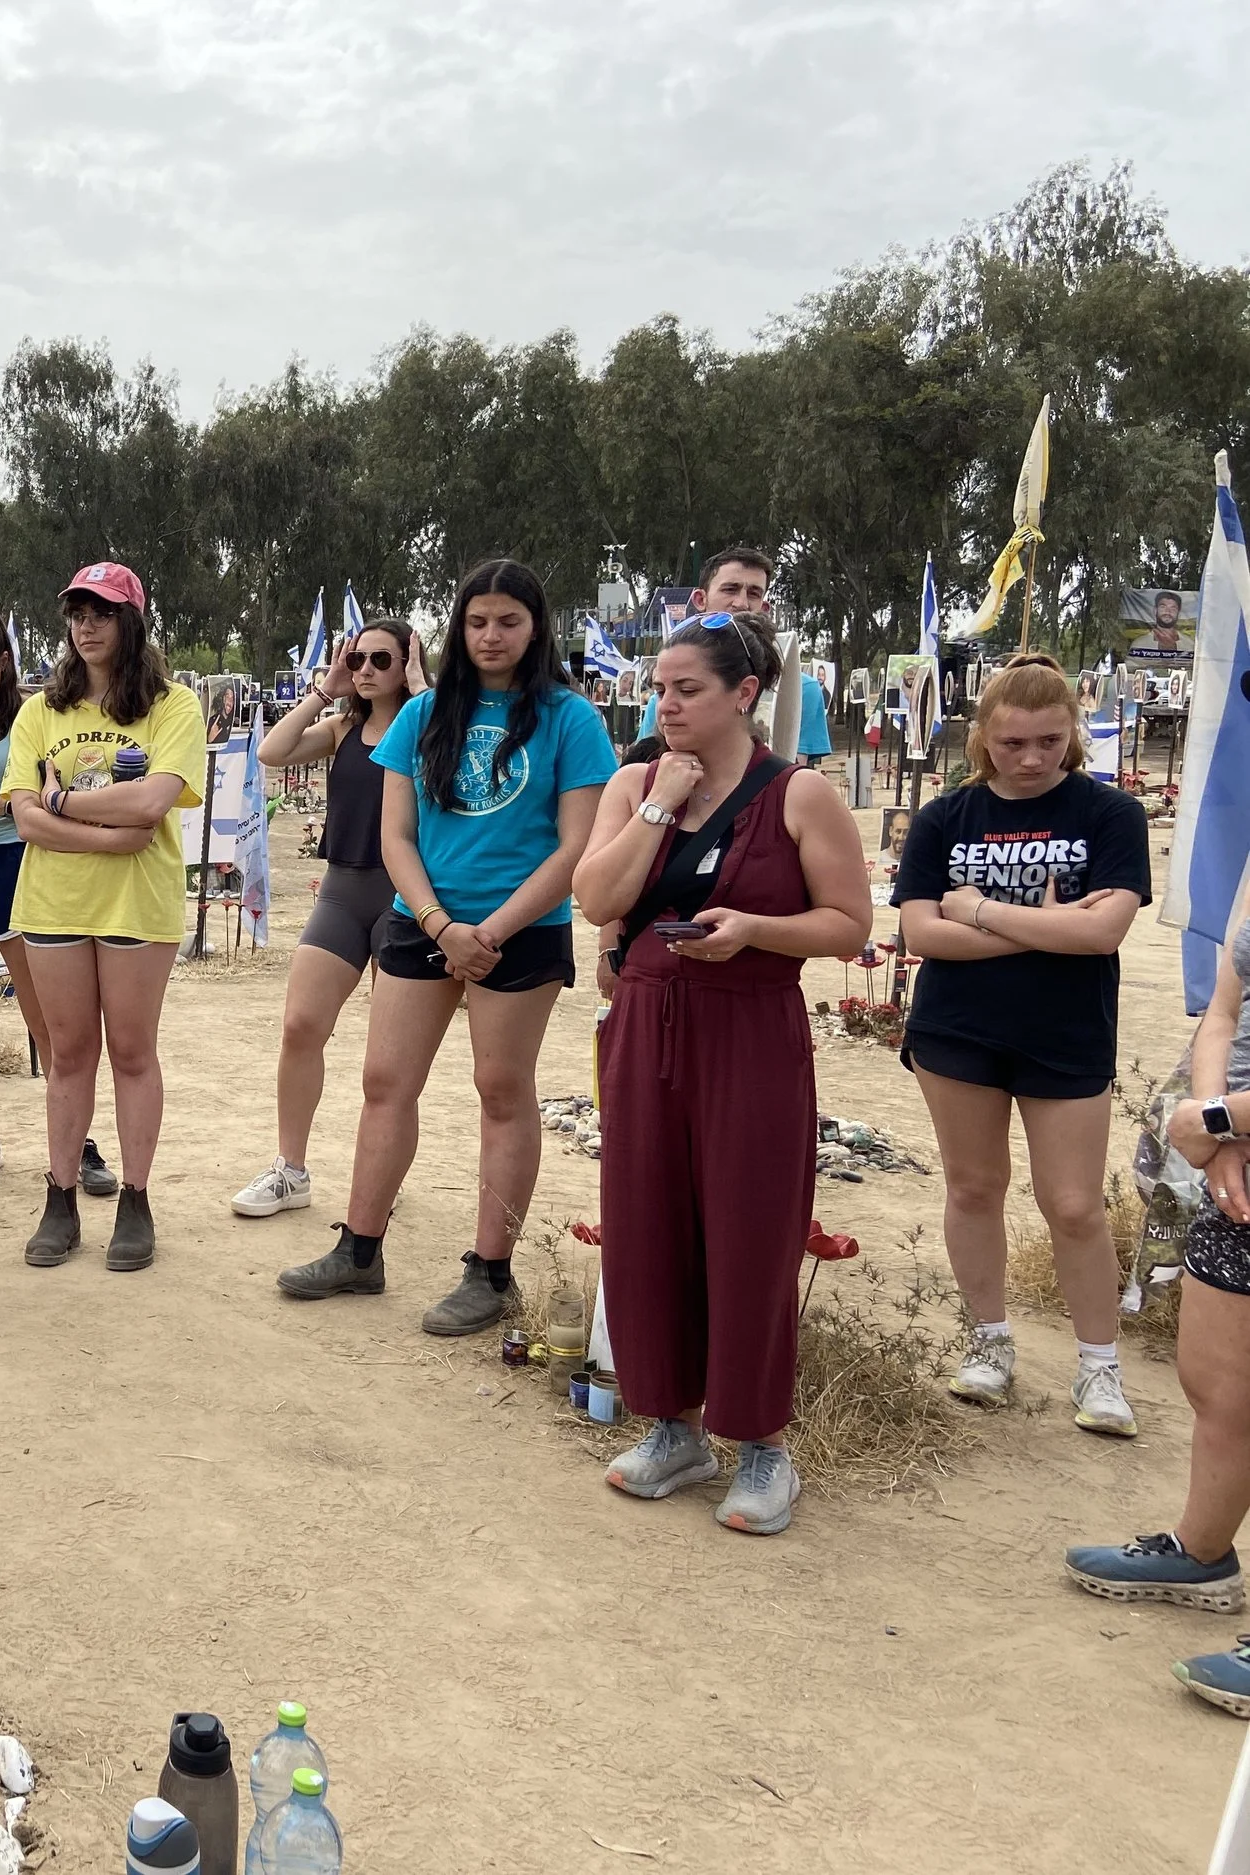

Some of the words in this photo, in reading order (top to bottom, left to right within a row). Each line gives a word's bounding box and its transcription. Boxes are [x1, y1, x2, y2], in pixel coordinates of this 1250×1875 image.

[85, 566, 106, 581] B
[281, 686, 291, 696] 92
[466, 801, 480, 811] THE
[481, 788, 511, 810] ROCKIES
[983, 833, 1003, 842] BLUE
[1004, 832, 1030, 841] VALLEY
[1031, 831, 1052, 840] WEST
[948, 839, 1088, 865] SENIORS
